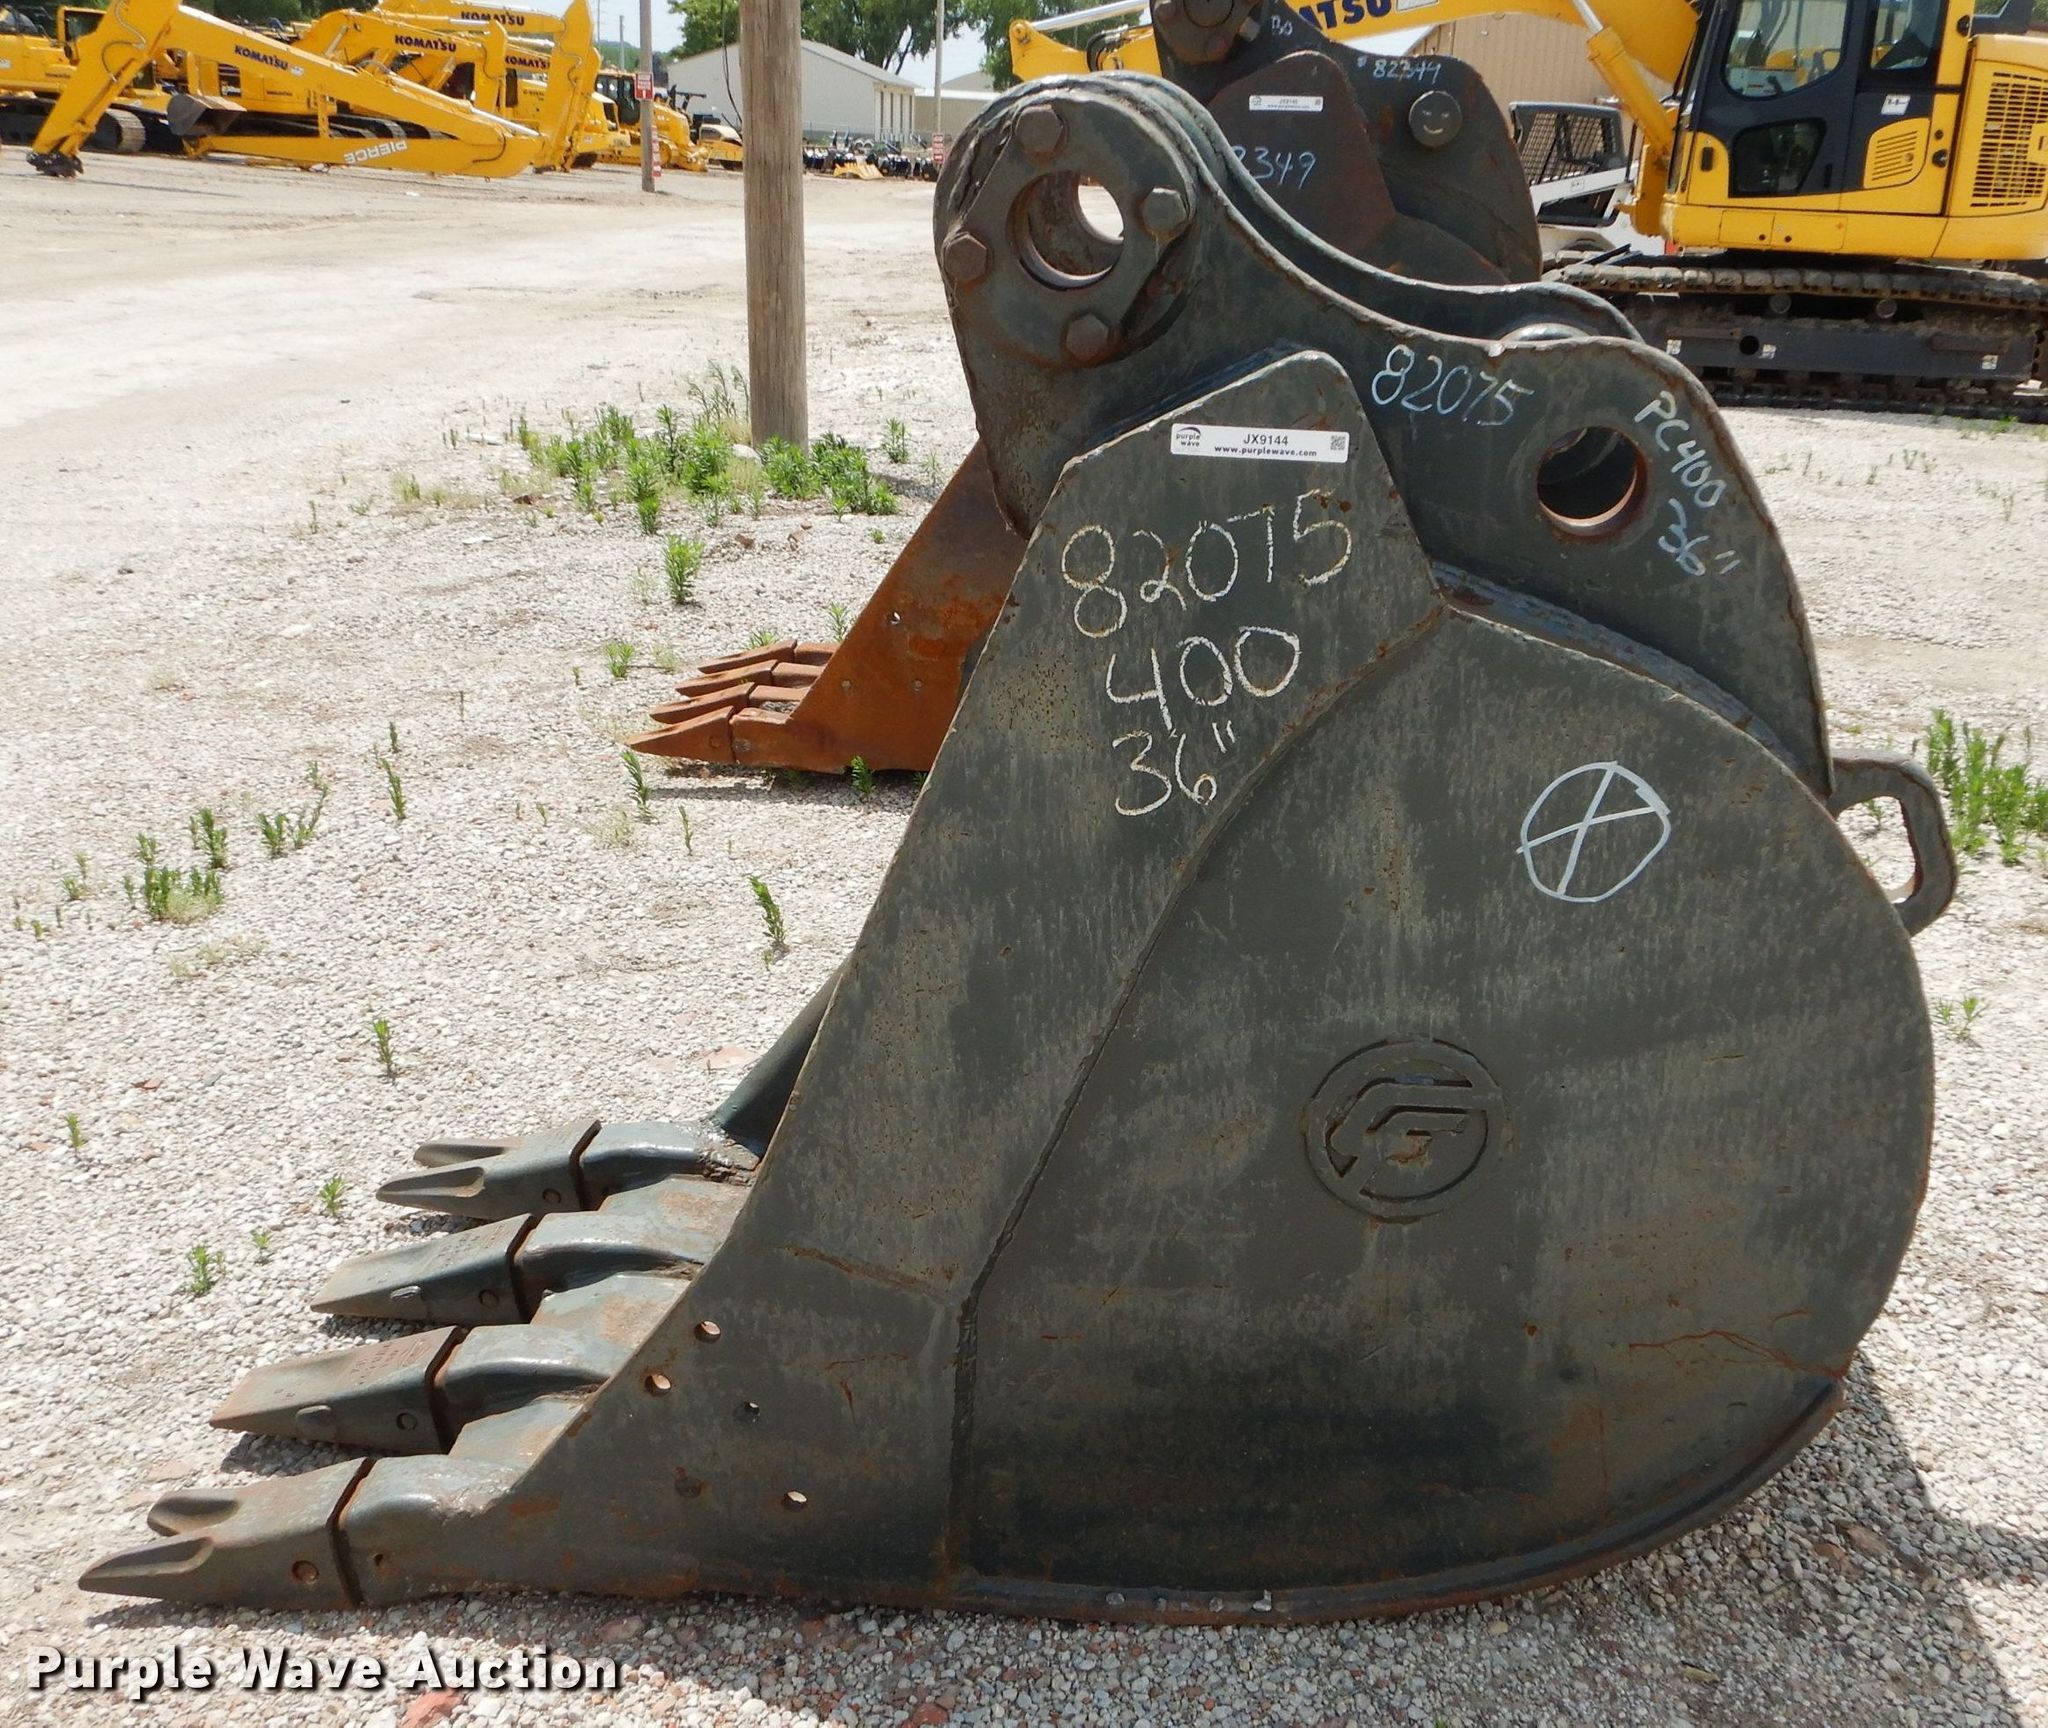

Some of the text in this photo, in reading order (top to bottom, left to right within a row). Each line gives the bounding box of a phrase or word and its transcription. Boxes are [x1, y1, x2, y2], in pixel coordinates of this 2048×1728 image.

[395, 35, 457, 52] KOMATSU
[234, 45, 289, 71] KOMATSU
[1371, 343, 1536, 427] 82075
[1176, 433, 1200, 441] purple
[1243, 434, 1289, 446] JX9144
[1634, 390, 1727, 509] PC400
[1214, 445, 1317, 456] www.purplewave.com
[1062, 488, 1352, 638] 82075
[1106, 626, 1302, 740] 400
